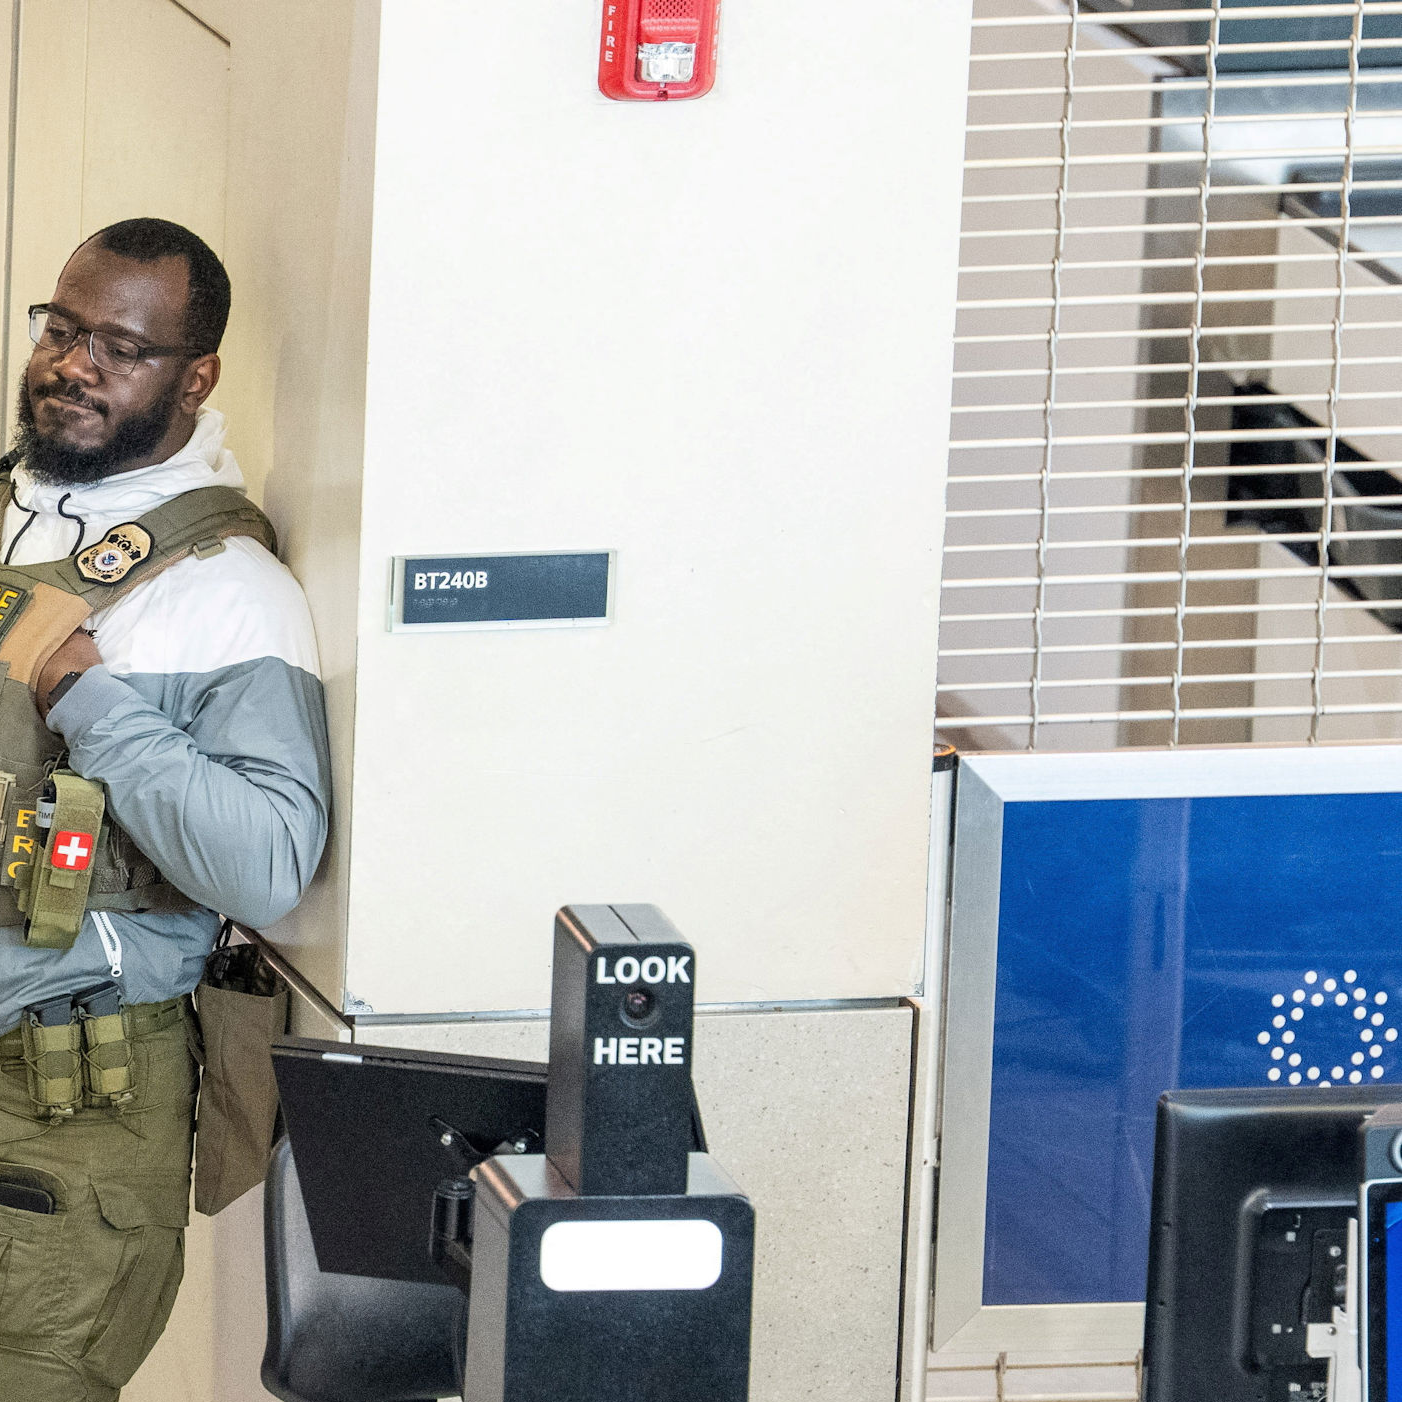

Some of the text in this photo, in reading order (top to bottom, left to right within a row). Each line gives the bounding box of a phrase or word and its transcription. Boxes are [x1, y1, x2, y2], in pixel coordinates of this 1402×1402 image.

[605, 5, 616, 62] FIRE
[414, 571, 488, 590] BT240B
[596, 956, 691, 984] LOOK
[593, 1037, 685, 1065] HERE
